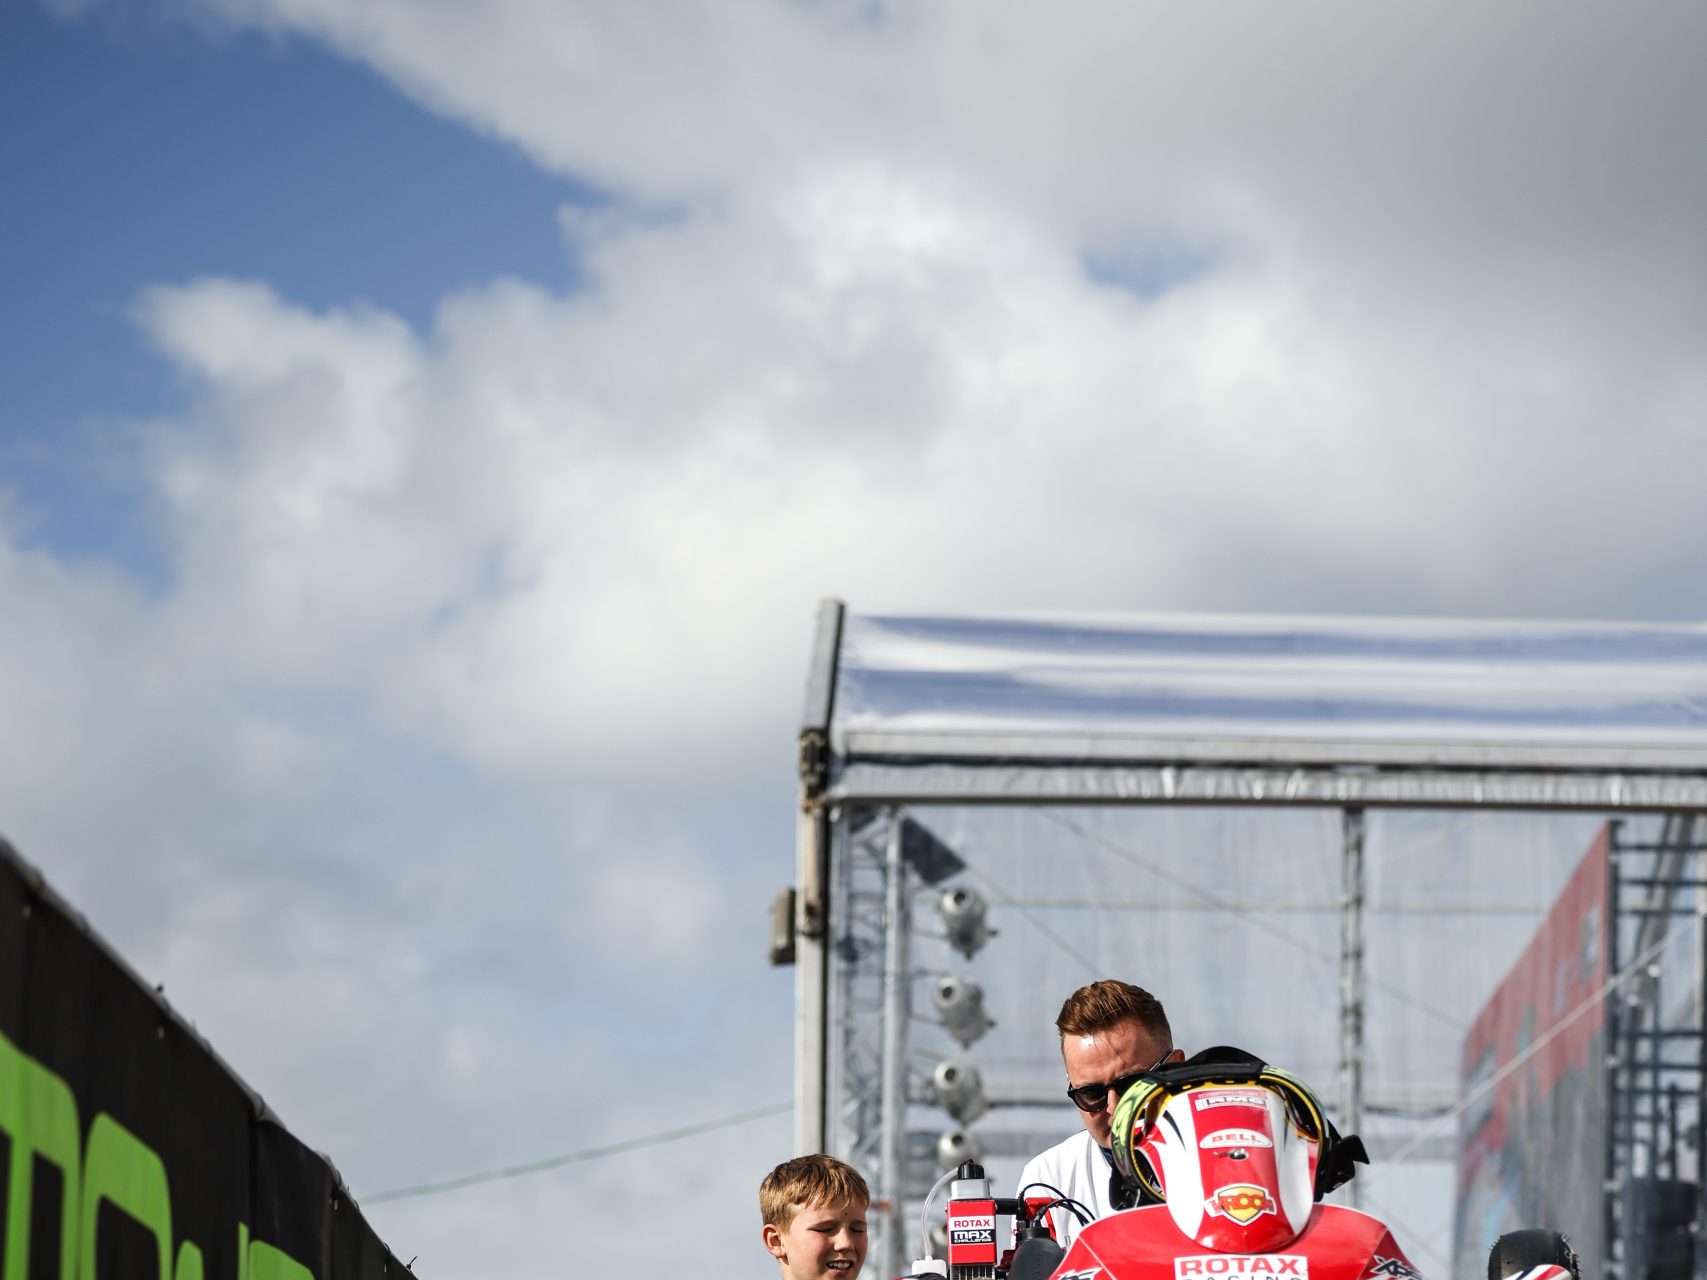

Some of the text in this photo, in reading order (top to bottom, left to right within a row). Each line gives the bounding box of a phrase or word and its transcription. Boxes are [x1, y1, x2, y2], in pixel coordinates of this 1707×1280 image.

[1211, 1133, 1262, 1144] BELL
[953, 1219, 991, 1229] ROTAX
[953, 1230, 992, 1241] MAX
[1179, 1257, 1301, 1277] ROTAX
